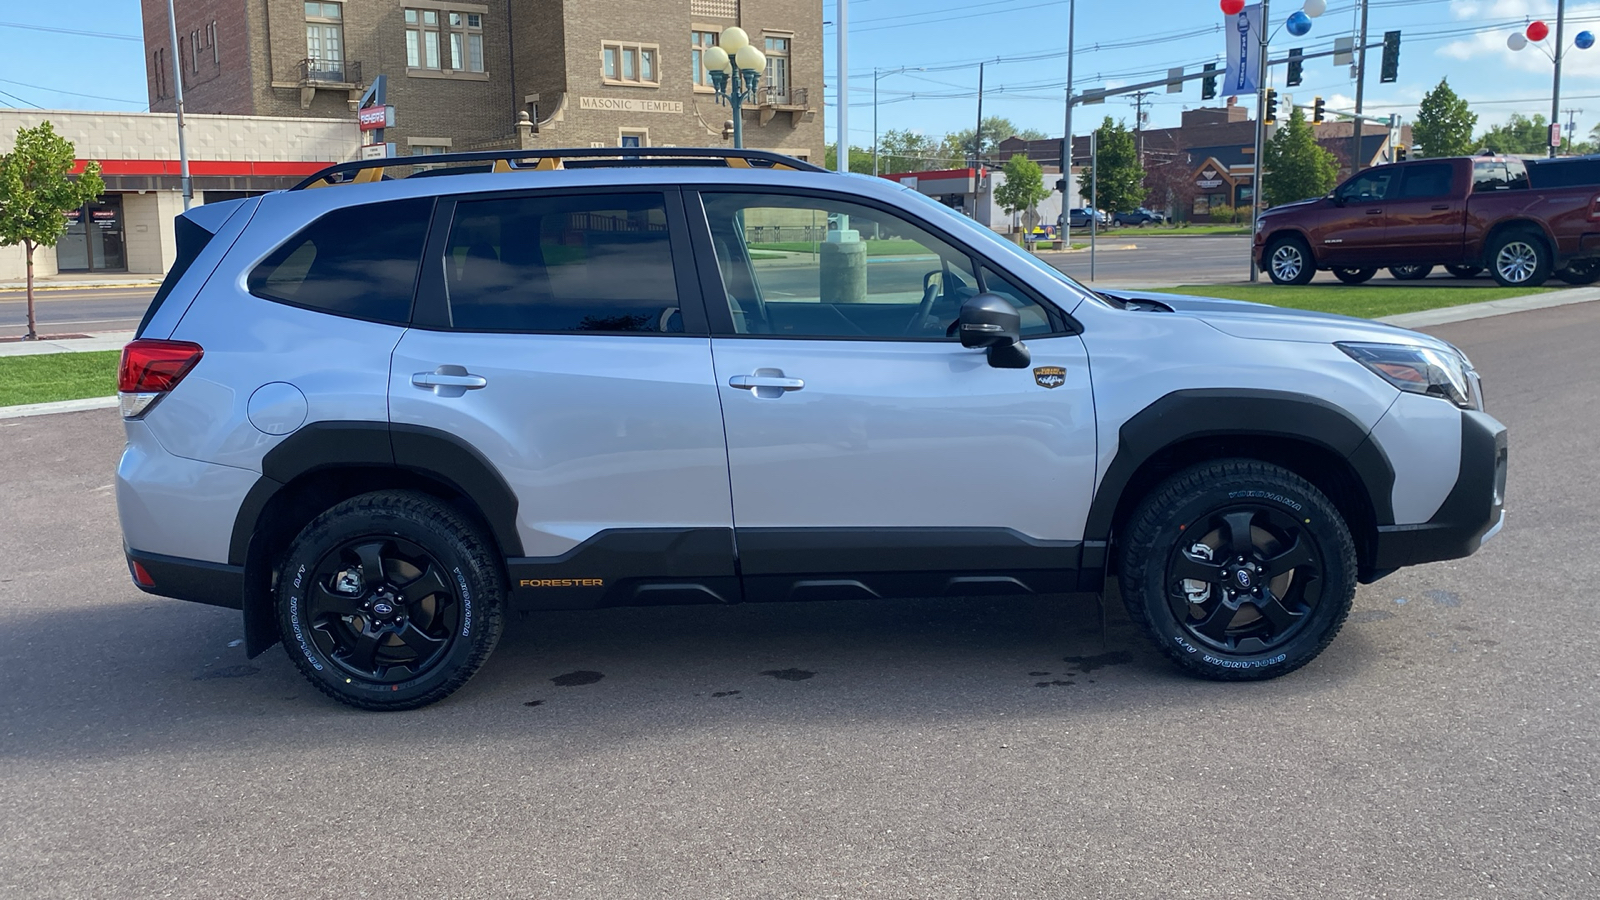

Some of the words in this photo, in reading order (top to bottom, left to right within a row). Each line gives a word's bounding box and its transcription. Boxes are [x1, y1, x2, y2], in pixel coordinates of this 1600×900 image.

[582, 98, 632, 110] MASONIC
[641, 101, 682, 112] TEMPLE
[1228, 490, 1302, 511] YOKOHAMA
[293, 564, 306, 589] A/T
[520, 578, 603, 587] FORESTER
[453, 566, 472, 637] YOKOHAMA
[290, 596, 324, 671] GEOLANDAR
[1174, 635, 1198, 654] A/T
[1202, 652, 1287, 669] GEOLANDAR
